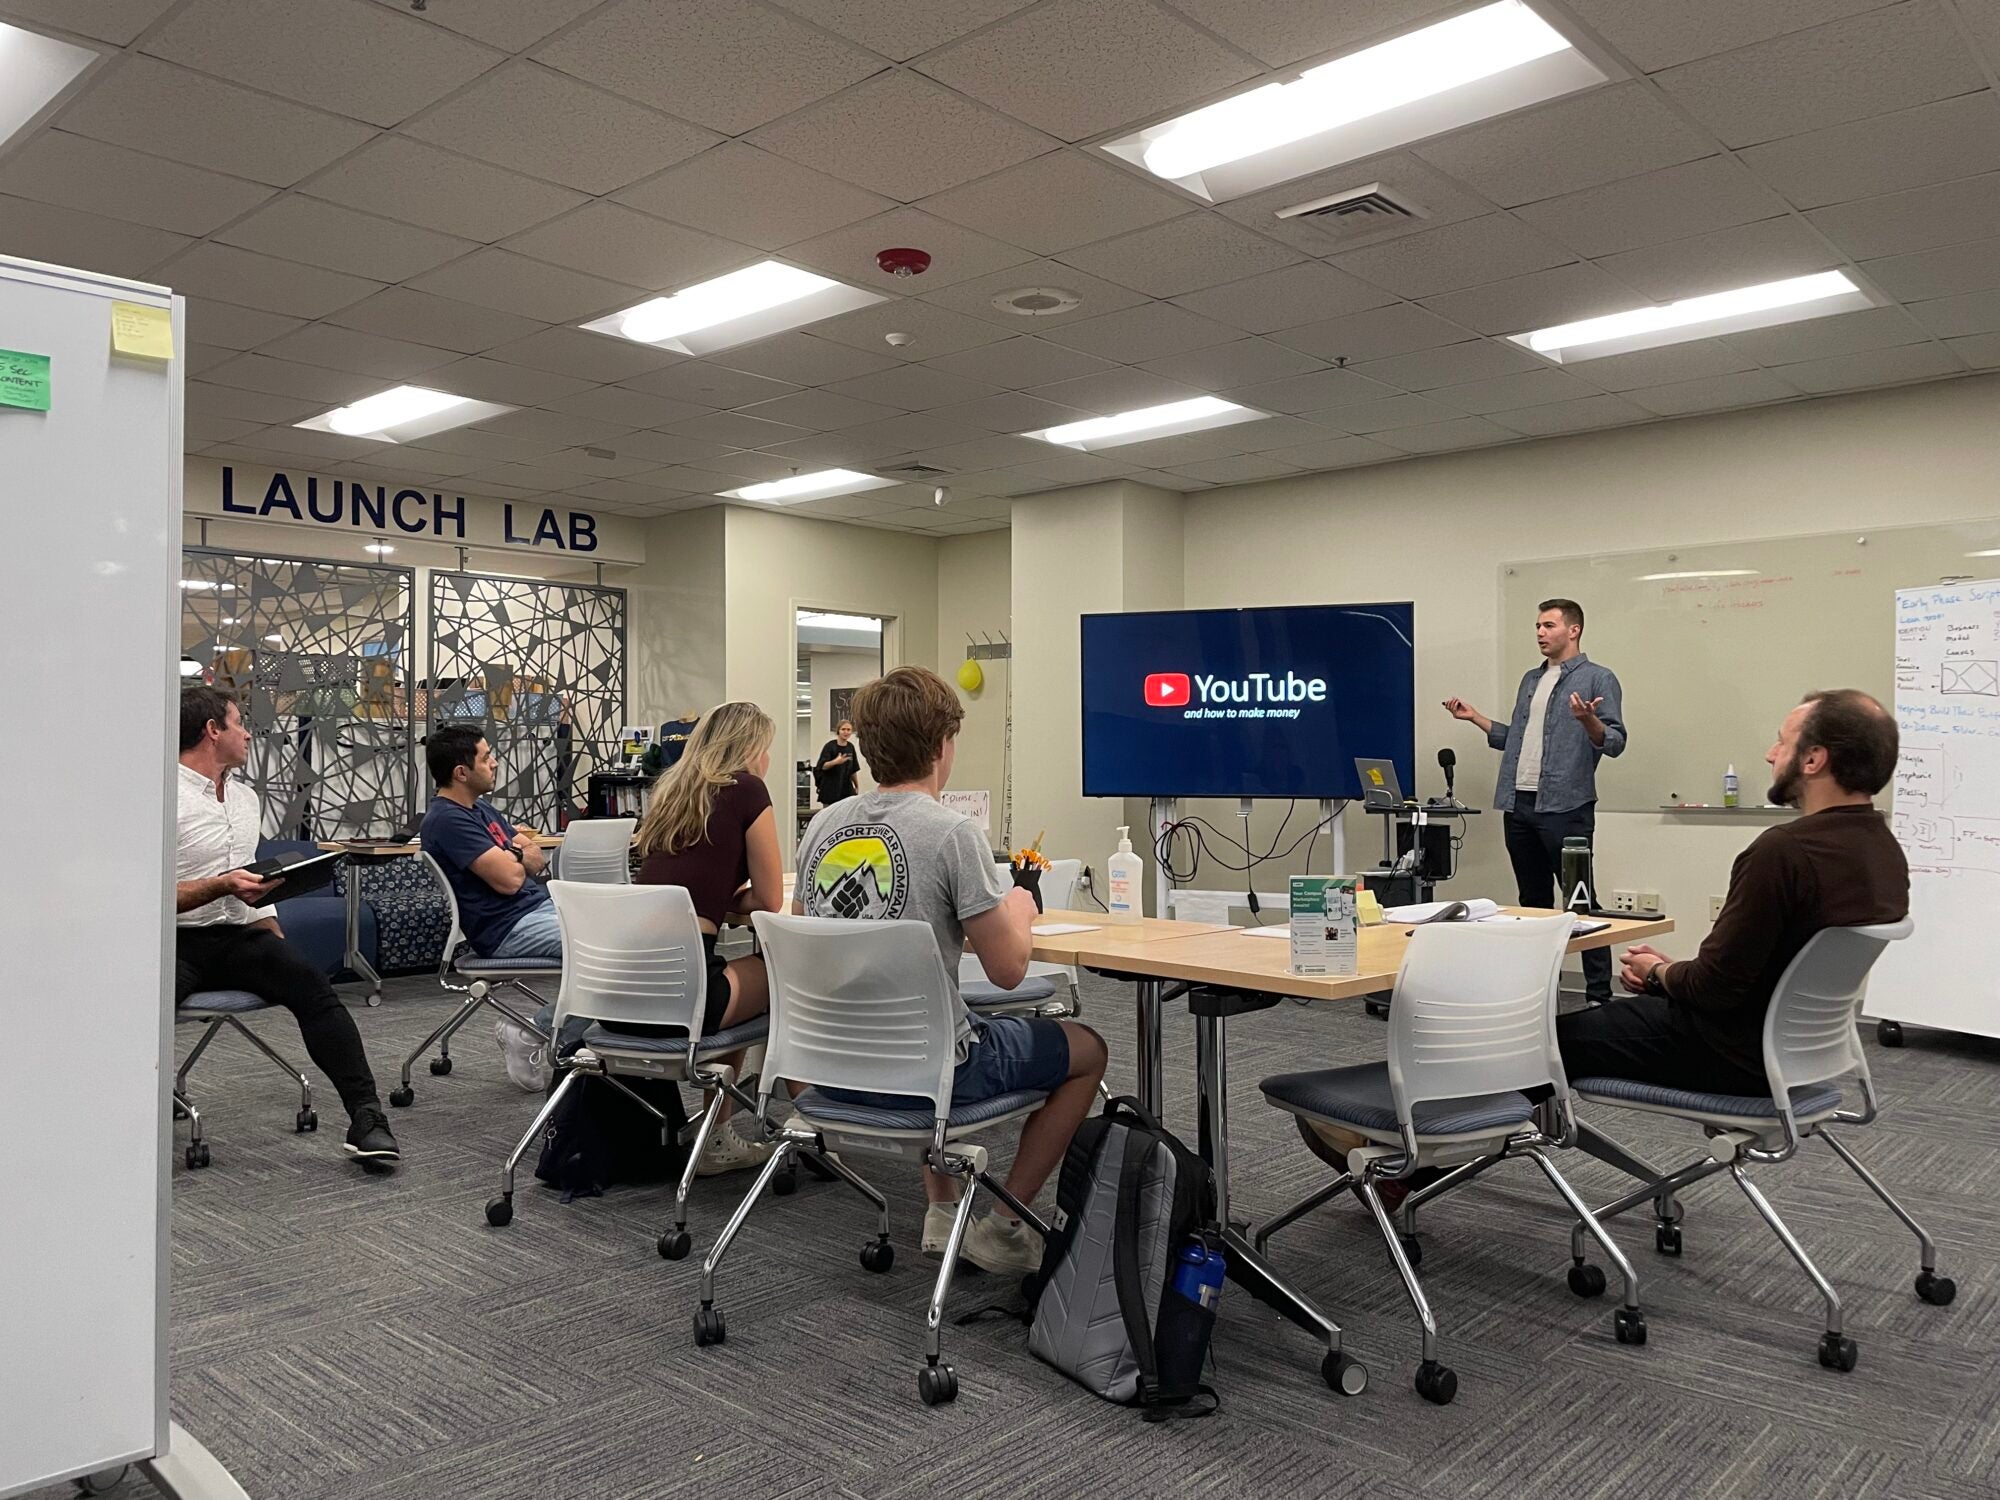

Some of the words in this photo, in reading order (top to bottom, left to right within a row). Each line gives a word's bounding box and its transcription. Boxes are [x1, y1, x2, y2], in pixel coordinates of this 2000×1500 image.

[0, 375, 44, 388] ONTENT
[222, 466, 466, 538] LAUNCH
[504, 503, 598, 552] LAB
[1194, 671, 1327, 702] YouTube
[1184, 708, 1203, 719] and
[1204, 708, 1225, 718] how
[1226, 708, 1238, 718] to
[1238, 707, 1265, 718] make
[1266, 708, 1301, 720] money
[806, 847, 827, 917] OLUMBIA
[827, 826, 899, 852] SPORTSWEAR
[883, 853, 906, 919] COMPAN
[1567, 880, 1592, 910] A
